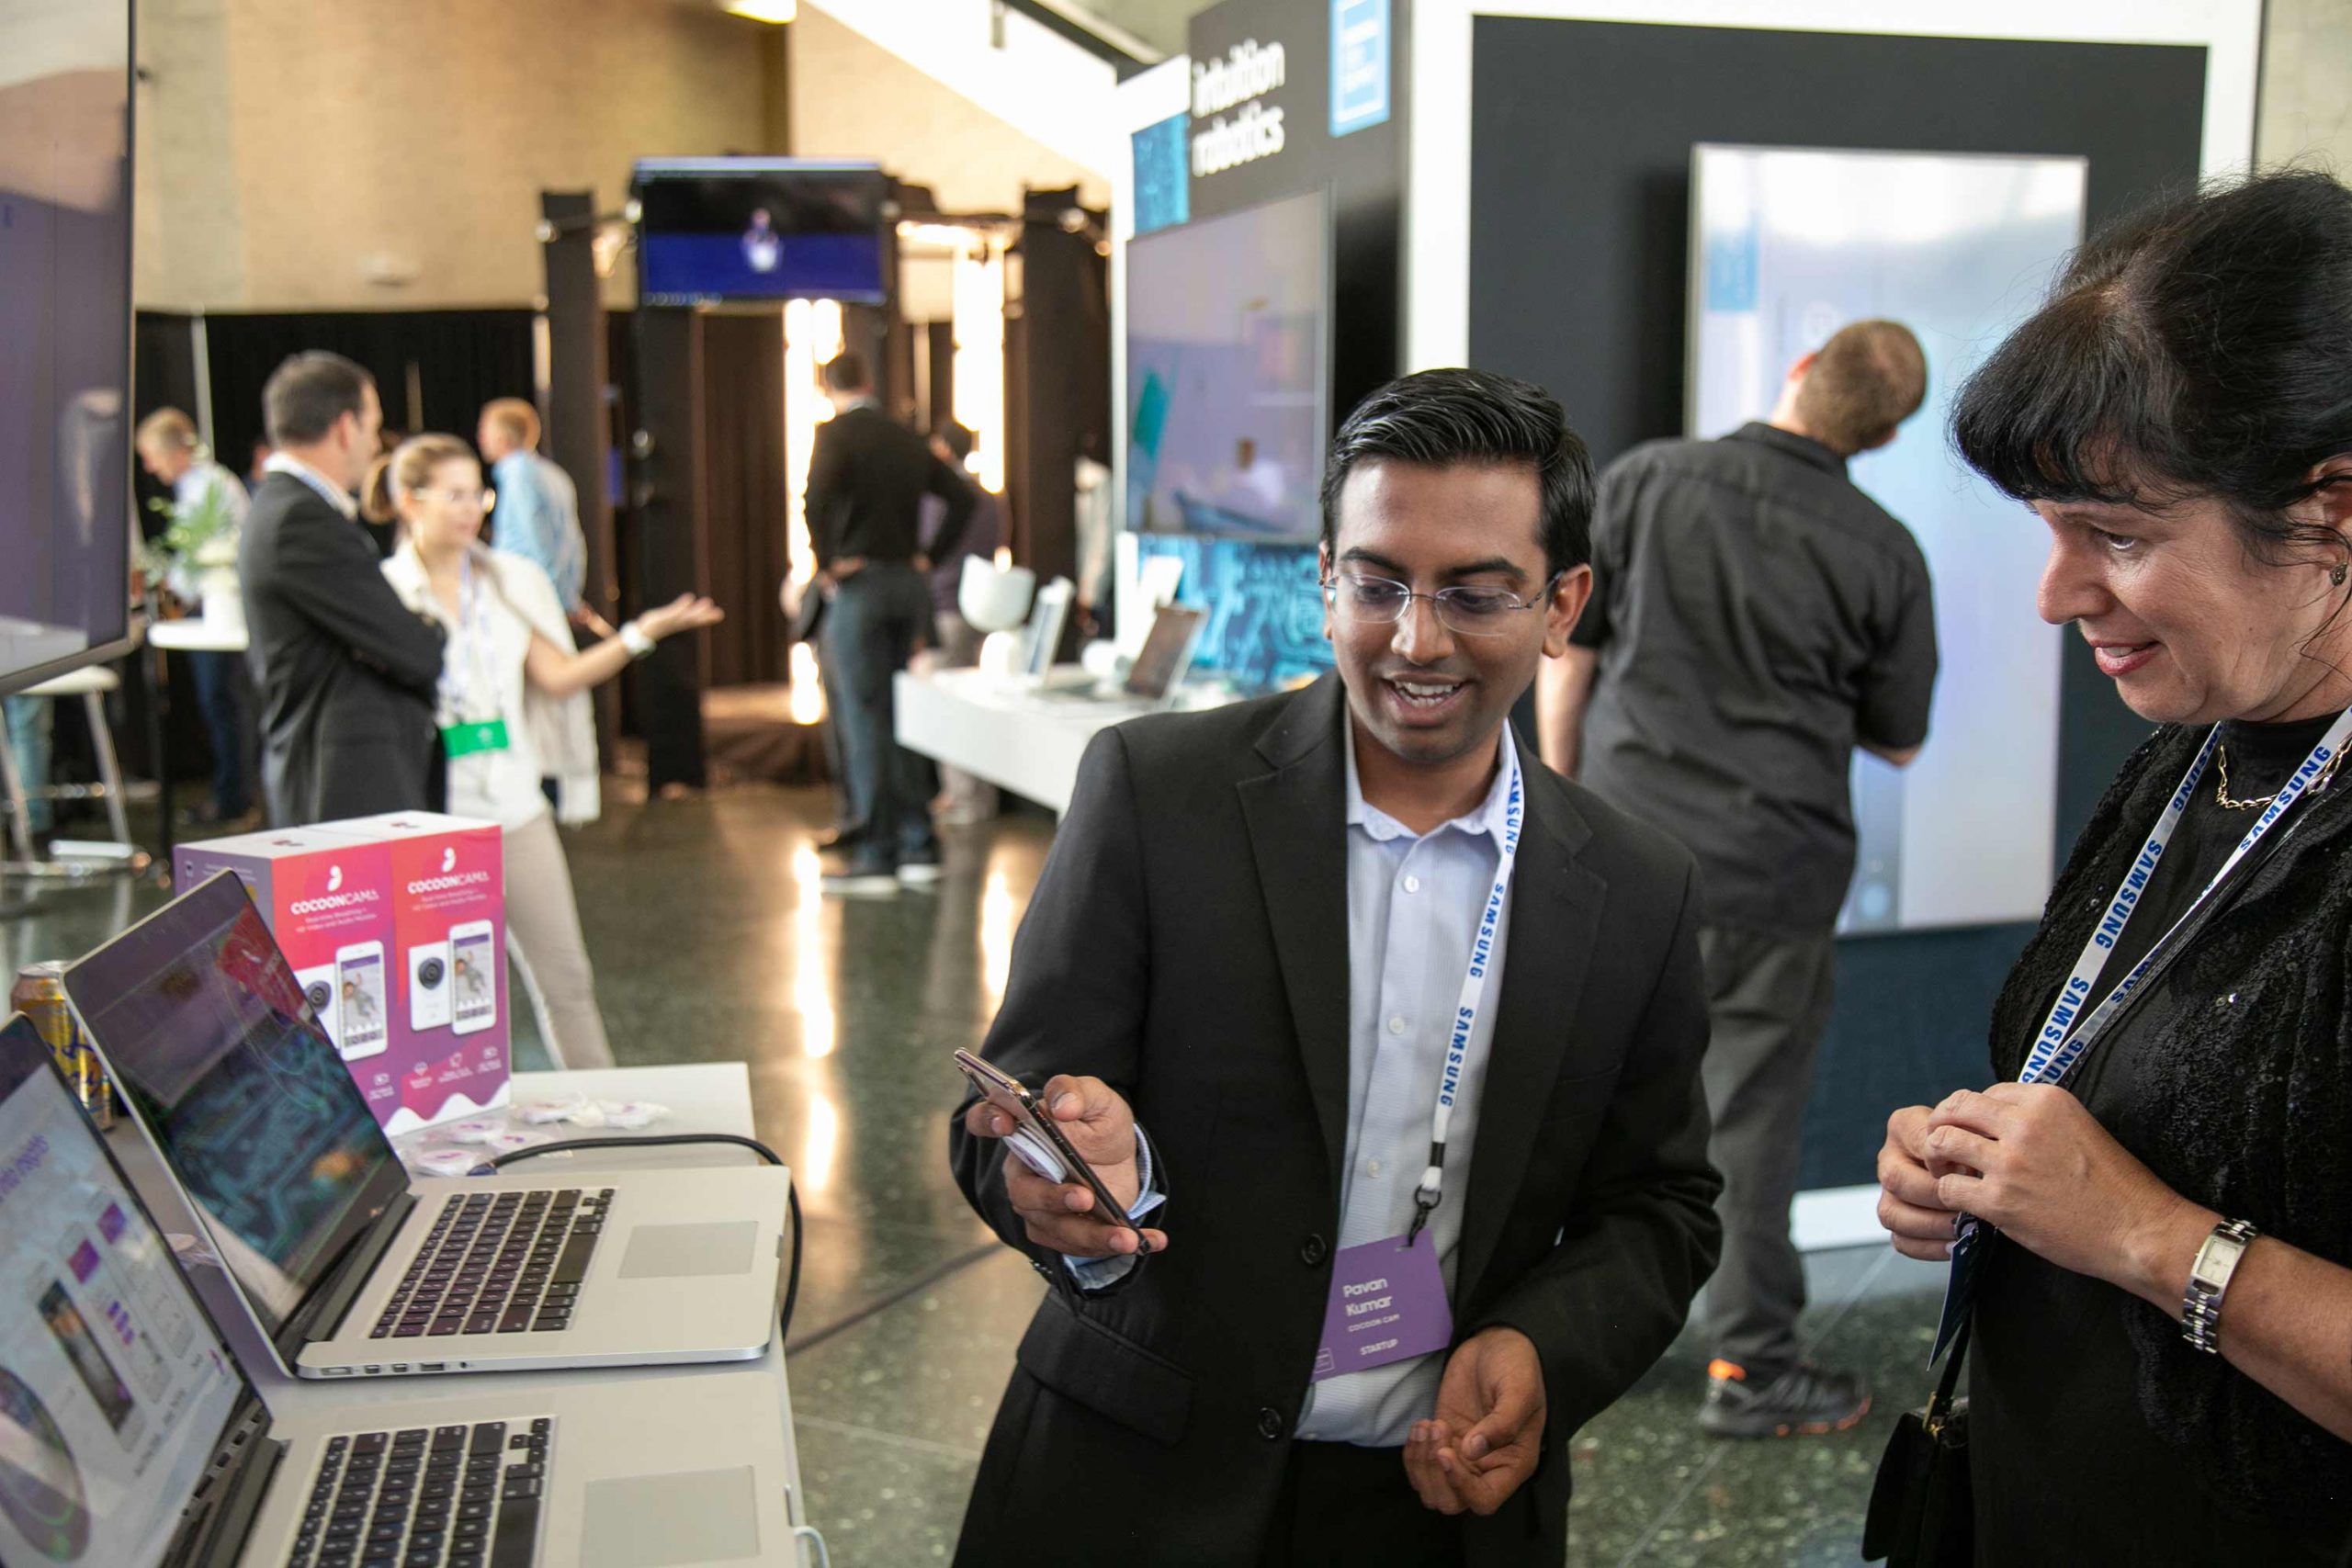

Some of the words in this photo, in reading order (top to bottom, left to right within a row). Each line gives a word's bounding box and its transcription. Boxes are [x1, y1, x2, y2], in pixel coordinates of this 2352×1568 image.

[2240, 746, 2331, 851] SAMSUNG
[1470, 884, 1504, 978] SAMSUNG
[2095, 840, 2162, 948] SAMSUNG
[1441, 1006, 1473, 1107] SAMSUNG
[1342, 1278, 1388, 1298] Pavan
[1345, 1295, 1393, 1316] Kumar
[1360, 1338, 1398, 1356] STARTUP
